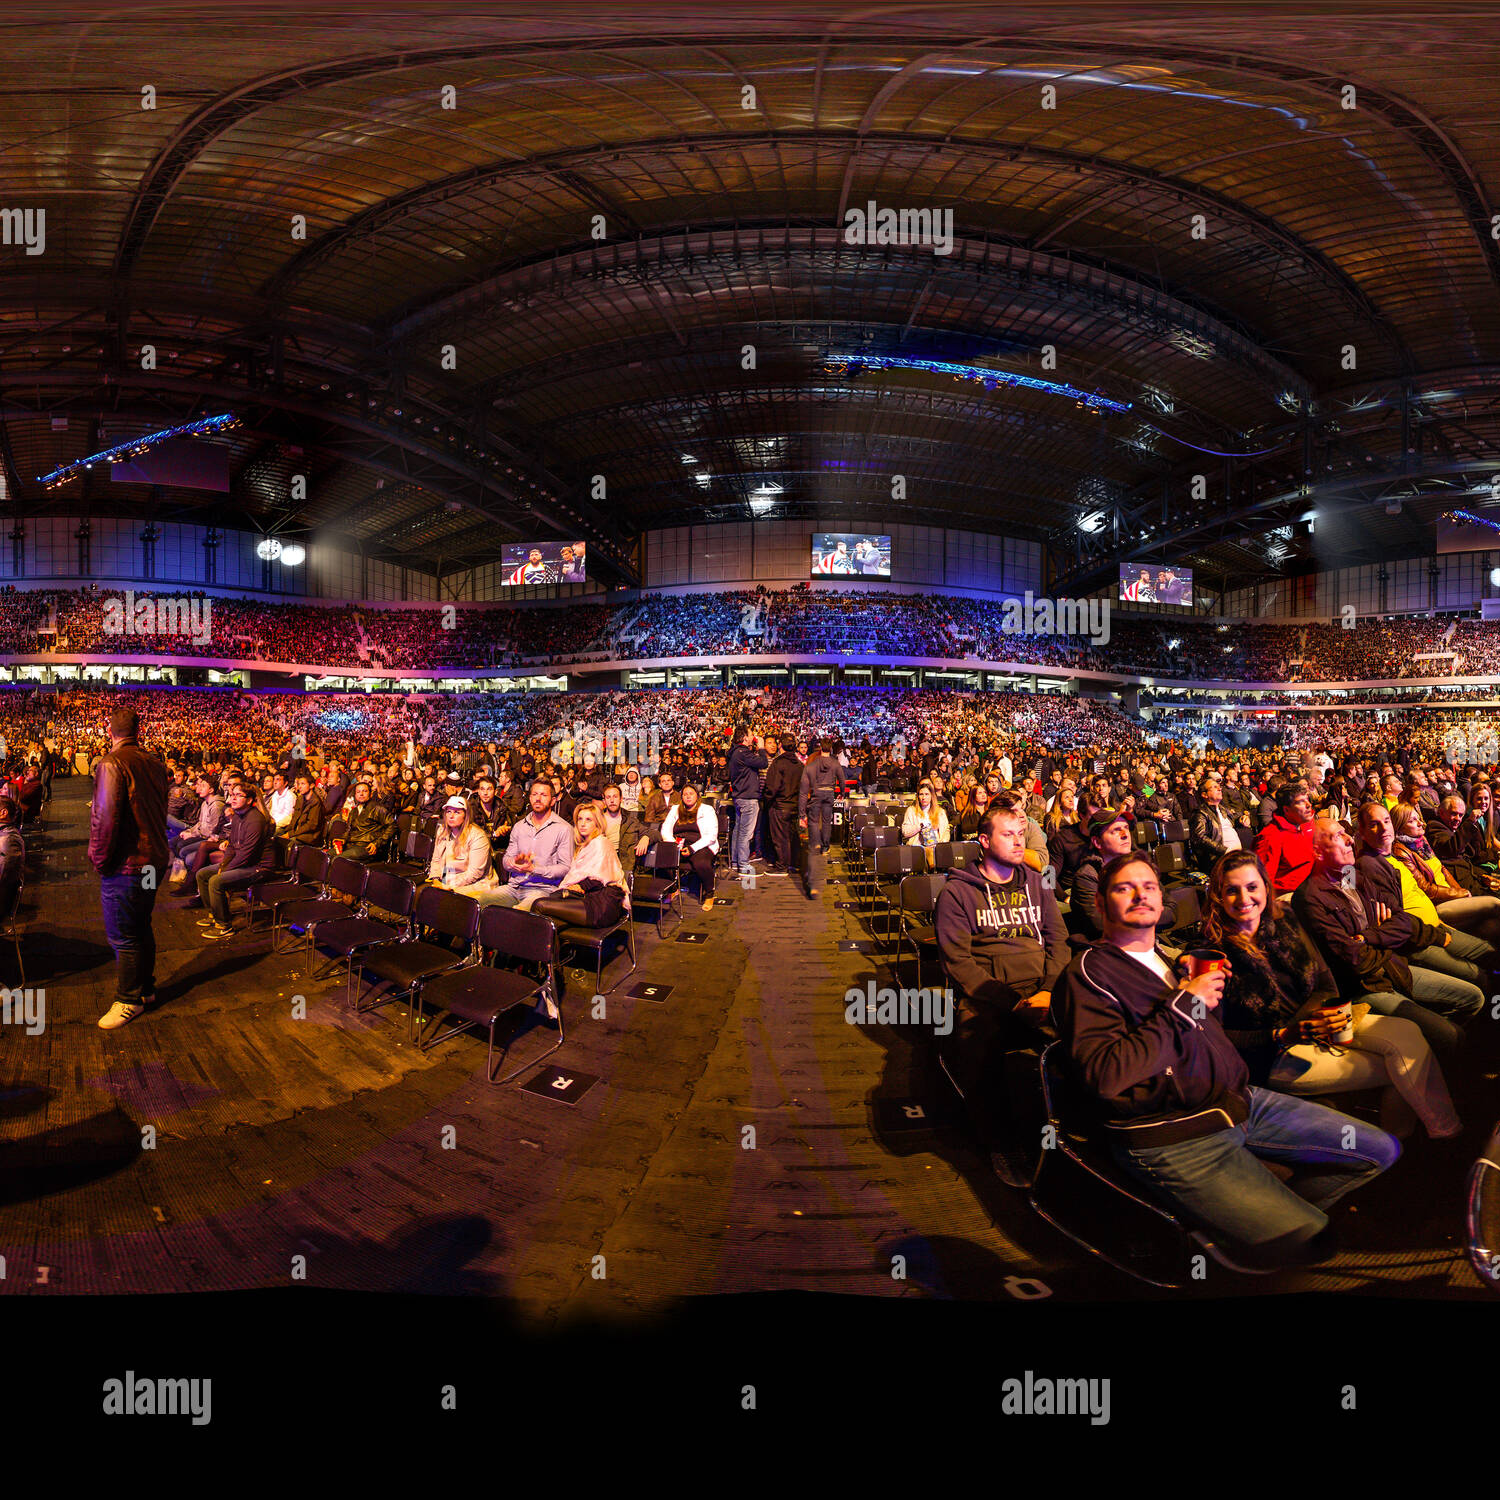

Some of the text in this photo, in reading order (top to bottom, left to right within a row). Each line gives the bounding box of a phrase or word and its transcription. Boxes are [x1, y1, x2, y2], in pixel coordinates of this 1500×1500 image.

[987, 891, 1027, 909] SURF
[644, 987, 658, 996] S
[551, 1075, 574, 1090] R
[902, 1105, 926, 1119] R
[1003, 1276, 1053, 1300] Q
